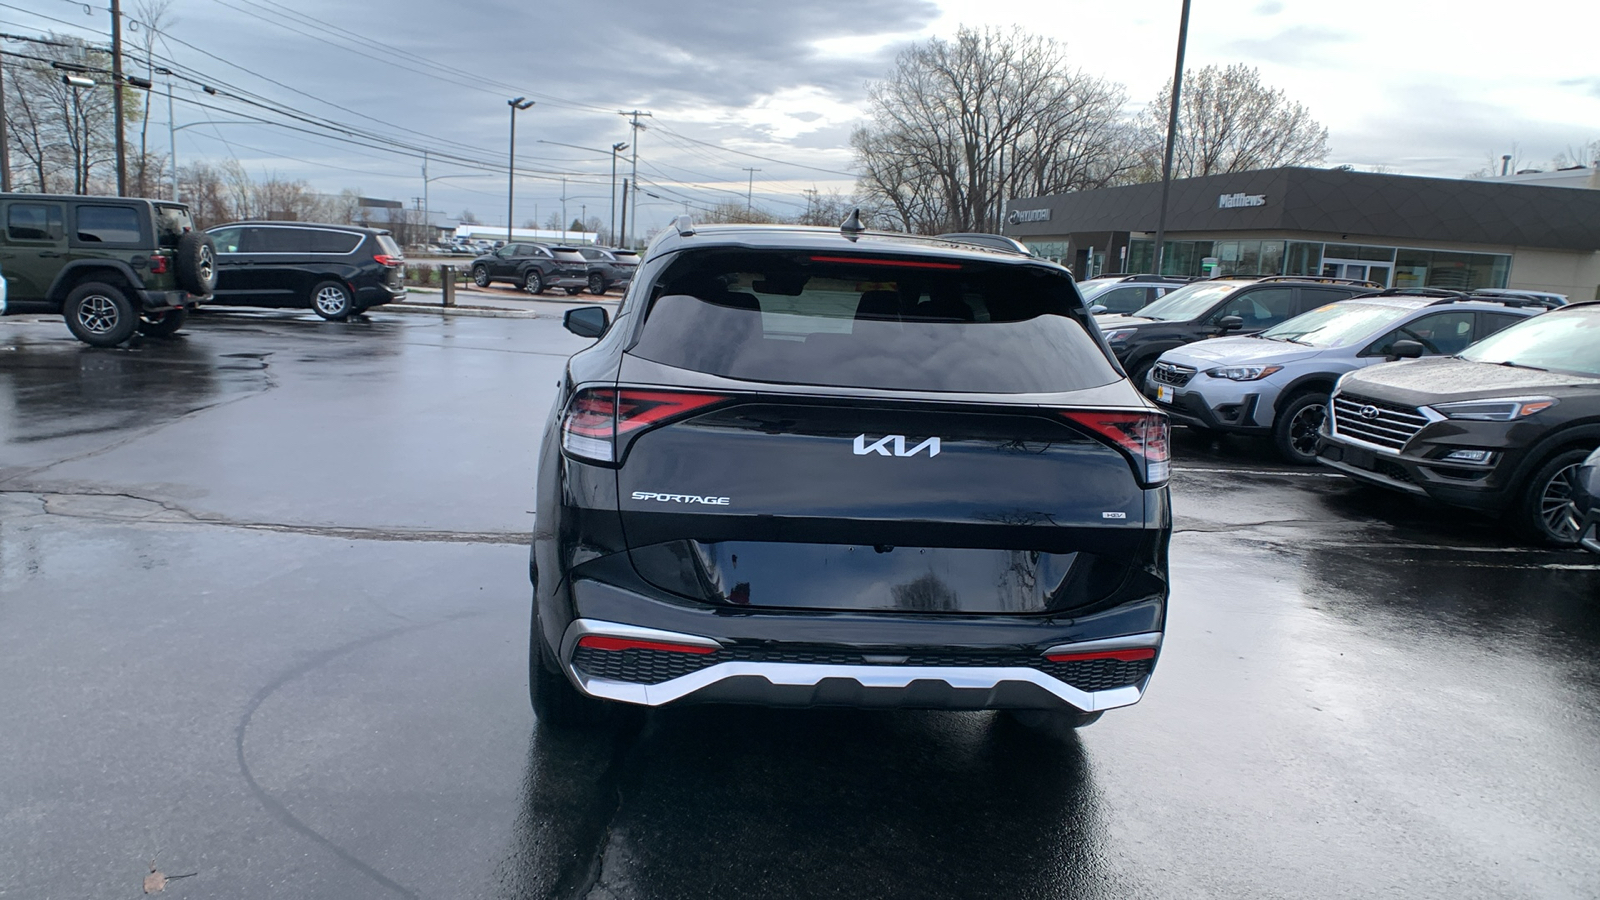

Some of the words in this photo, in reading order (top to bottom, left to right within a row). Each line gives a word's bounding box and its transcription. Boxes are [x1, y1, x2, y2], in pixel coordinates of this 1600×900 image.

[1219, 192, 1266, 208] Matthews
[853, 433, 941, 458] KIA
[631, 491, 731, 506] SPORTAGE
